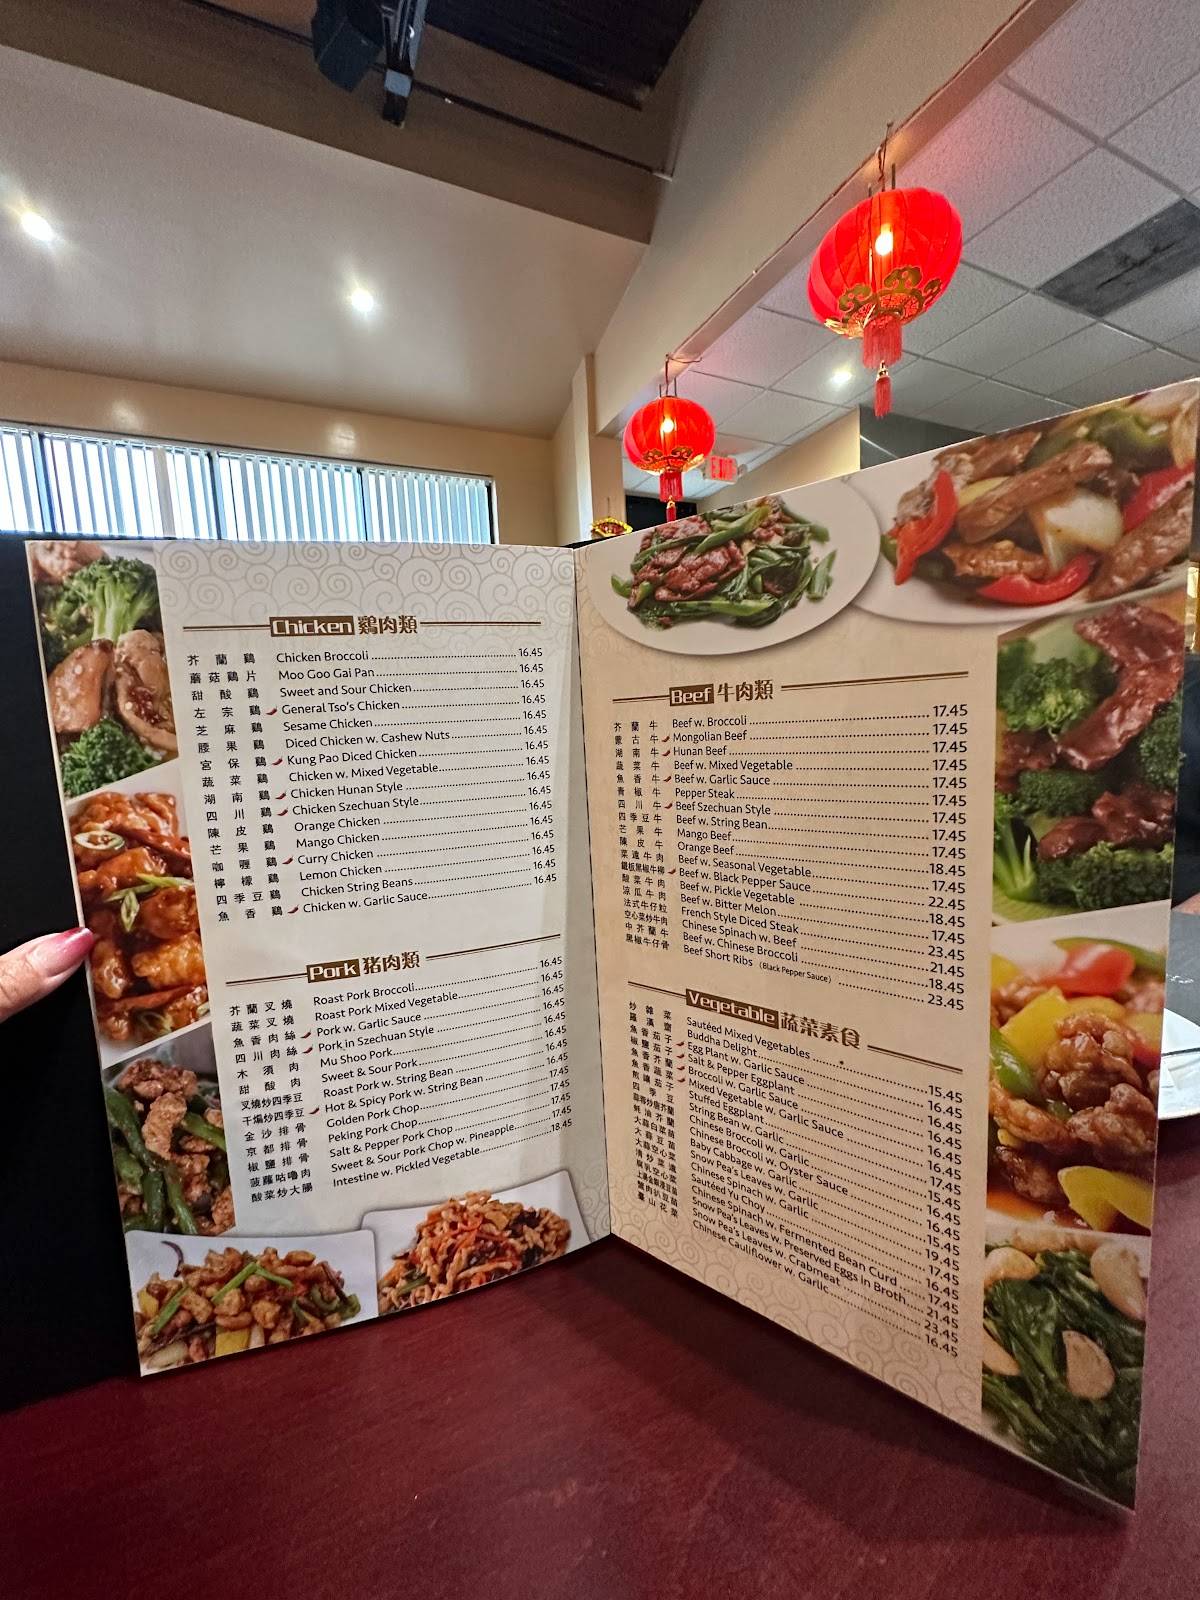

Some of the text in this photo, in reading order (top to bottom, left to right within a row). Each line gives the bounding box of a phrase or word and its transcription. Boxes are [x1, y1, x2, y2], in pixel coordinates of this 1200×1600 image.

[272, 619, 353, 636] Chicken
[276, 647, 543, 664] Chicken Broccoli 16.45
[278, 663, 544, 681] Moo Goo Gai Pan 16.45
[279, 678, 545, 698] Sweet and Sour Chicken 16.45
[671, 688, 712, 705] Beef
[717, 679, 774, 703] 牛肉類
[281, 694, 546, 715] General Tso's Chicken 16.45
[672, 703, 969, 729] Beef w. Broccoli 17.45
[285, 724, 548, 749] Diced Chicken w. Cashew Nuts 16.45
[672, 722, 968, 745] Mongolian Beef 17.45
[287, 739, 549, 767] Kung Pao Diced Chicken 16.45
[673, 758, 968, 773] Beef w. Mixed Vegetable 17.45
[290, 770, 551, 799] Chicken Hunan Style 16.45
[674, 787, 967, 808] Pepper Steak 17.45
[618, 799, 662, 811] 四川牛
[618, 812, 662, 823] 四季豆牛
[675, 800, 967, 825] Beef Szechuan Style 17.45
[678, 854, 966, 895] Beef w. Seasonal Vegetable 17.45
[302, 872, 558, 913] Chicken w. Garlic Sauce 16.45
[679, 867, 966, 912] Beef w. Black Pepper Sauce 22.45
[681, 905, 965, 962] French Style Diced Steak 23.45
[309, 962, 357, 981] Pork
[313, 955, 563, 1006] Roast Pork Broccoli 16.45
[314, 969, 564, 1022] Roast Pork Mixed Vegetable 16.45
[688, 990, 776, 1026] Vegetable
[320, 1011, 566, 1068] Mu Shoo Pork 16.45
[235, 1047, 298, 1064] 四川肉絲
[686, 1016, 963, 1104] Sautéed Mixed Vegetables 15.45
[324, 1051, 569, 1114] Hot & Spicy Pork w. String Bean 16.45
[687, 1041, 962, 1135] Egg Plant w. Garlic Sauce 16.45
[244, 1122, 307, 1142] 金沙排骨
[329, 1091, 571, 1158] Salt & Pepper Pork Chop 17.45
[688, 1077, 962, 1181] Mixed Vegetable w. Garlic Sauce 16.45
[246, 1137, 308, 1157] 京都排骨
[332, 1118, 573, 1188] Intestine w. Pickled Vegetable 18.45
[689, 1126, 961, 1241] Chinese Broccoli w. Oyster Sauce 16.45
[691, 1172, 960, 1301] Sautéed Yu Choy 16.45
